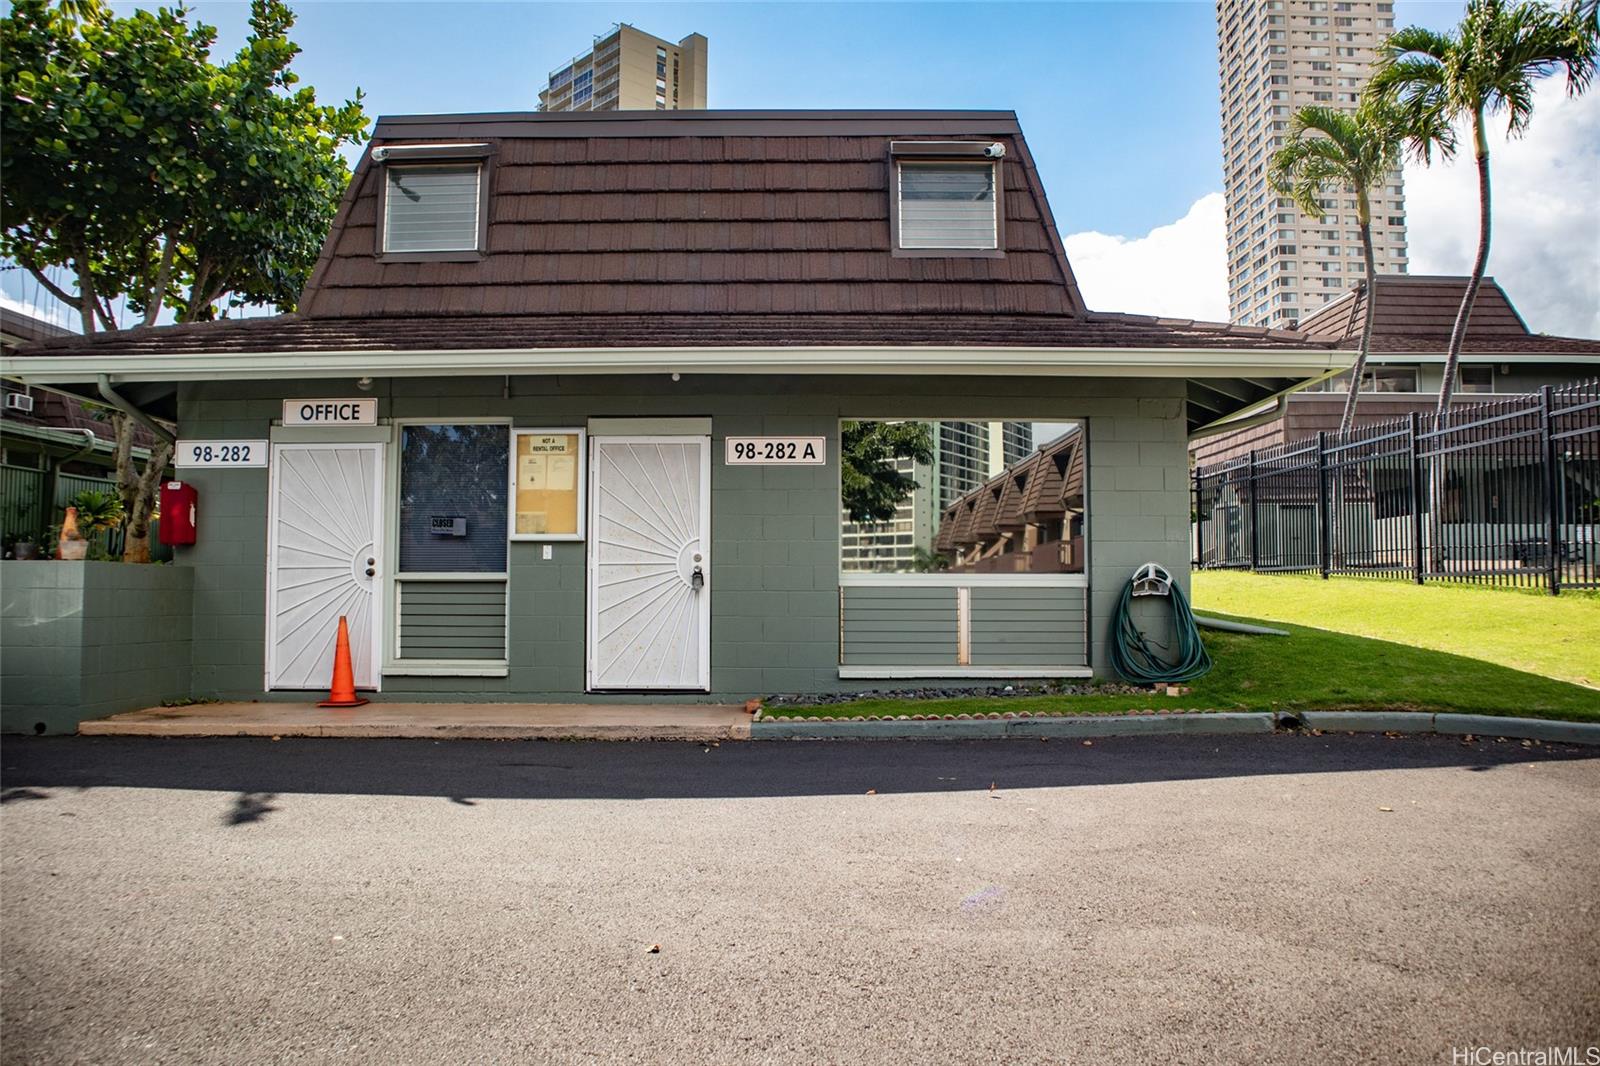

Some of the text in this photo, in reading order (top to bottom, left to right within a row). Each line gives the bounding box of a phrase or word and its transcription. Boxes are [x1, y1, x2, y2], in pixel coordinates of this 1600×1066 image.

[300, 404, 361, 421] OFFICE
[193, 445, 251, 462] 98-282
[735, 442, 816, 460] 98-282 A
